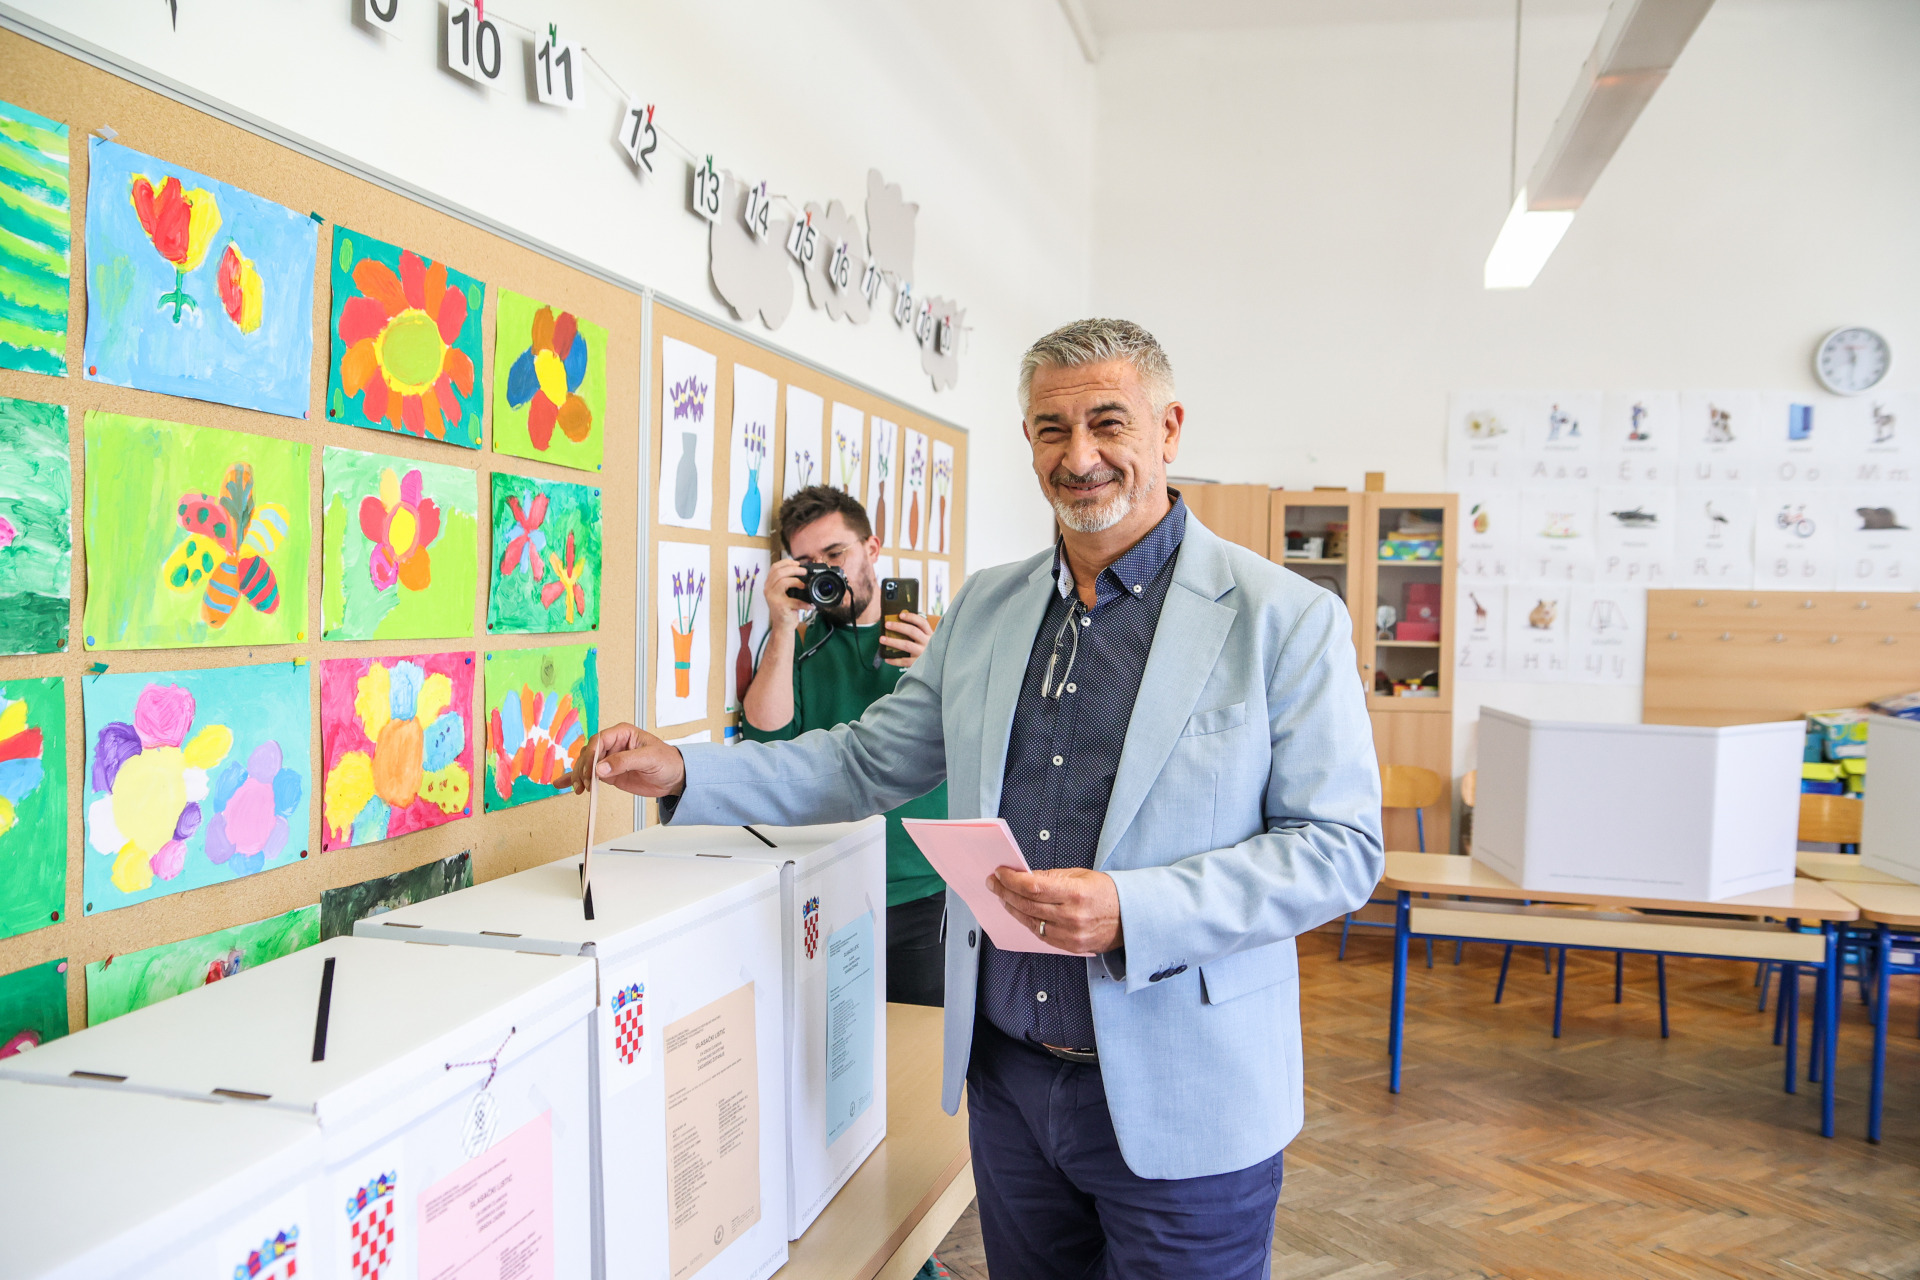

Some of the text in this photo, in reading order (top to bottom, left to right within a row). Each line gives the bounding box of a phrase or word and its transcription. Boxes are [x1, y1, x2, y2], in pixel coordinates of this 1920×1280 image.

[451, 8, 501, 79] 10
[538, 40, 574, 101] 11
[631, 108, 657, 174] 12
[697, 166, 719, 214] 13
[751, 187, 769, 236] 14
[795, 220, 815, 261] 15
[834, 248, 850, 288] 16
[866, 266, 881, 300] 17
[899, 289, 911, 323] 18
[920, 311, 931, 341] 19
